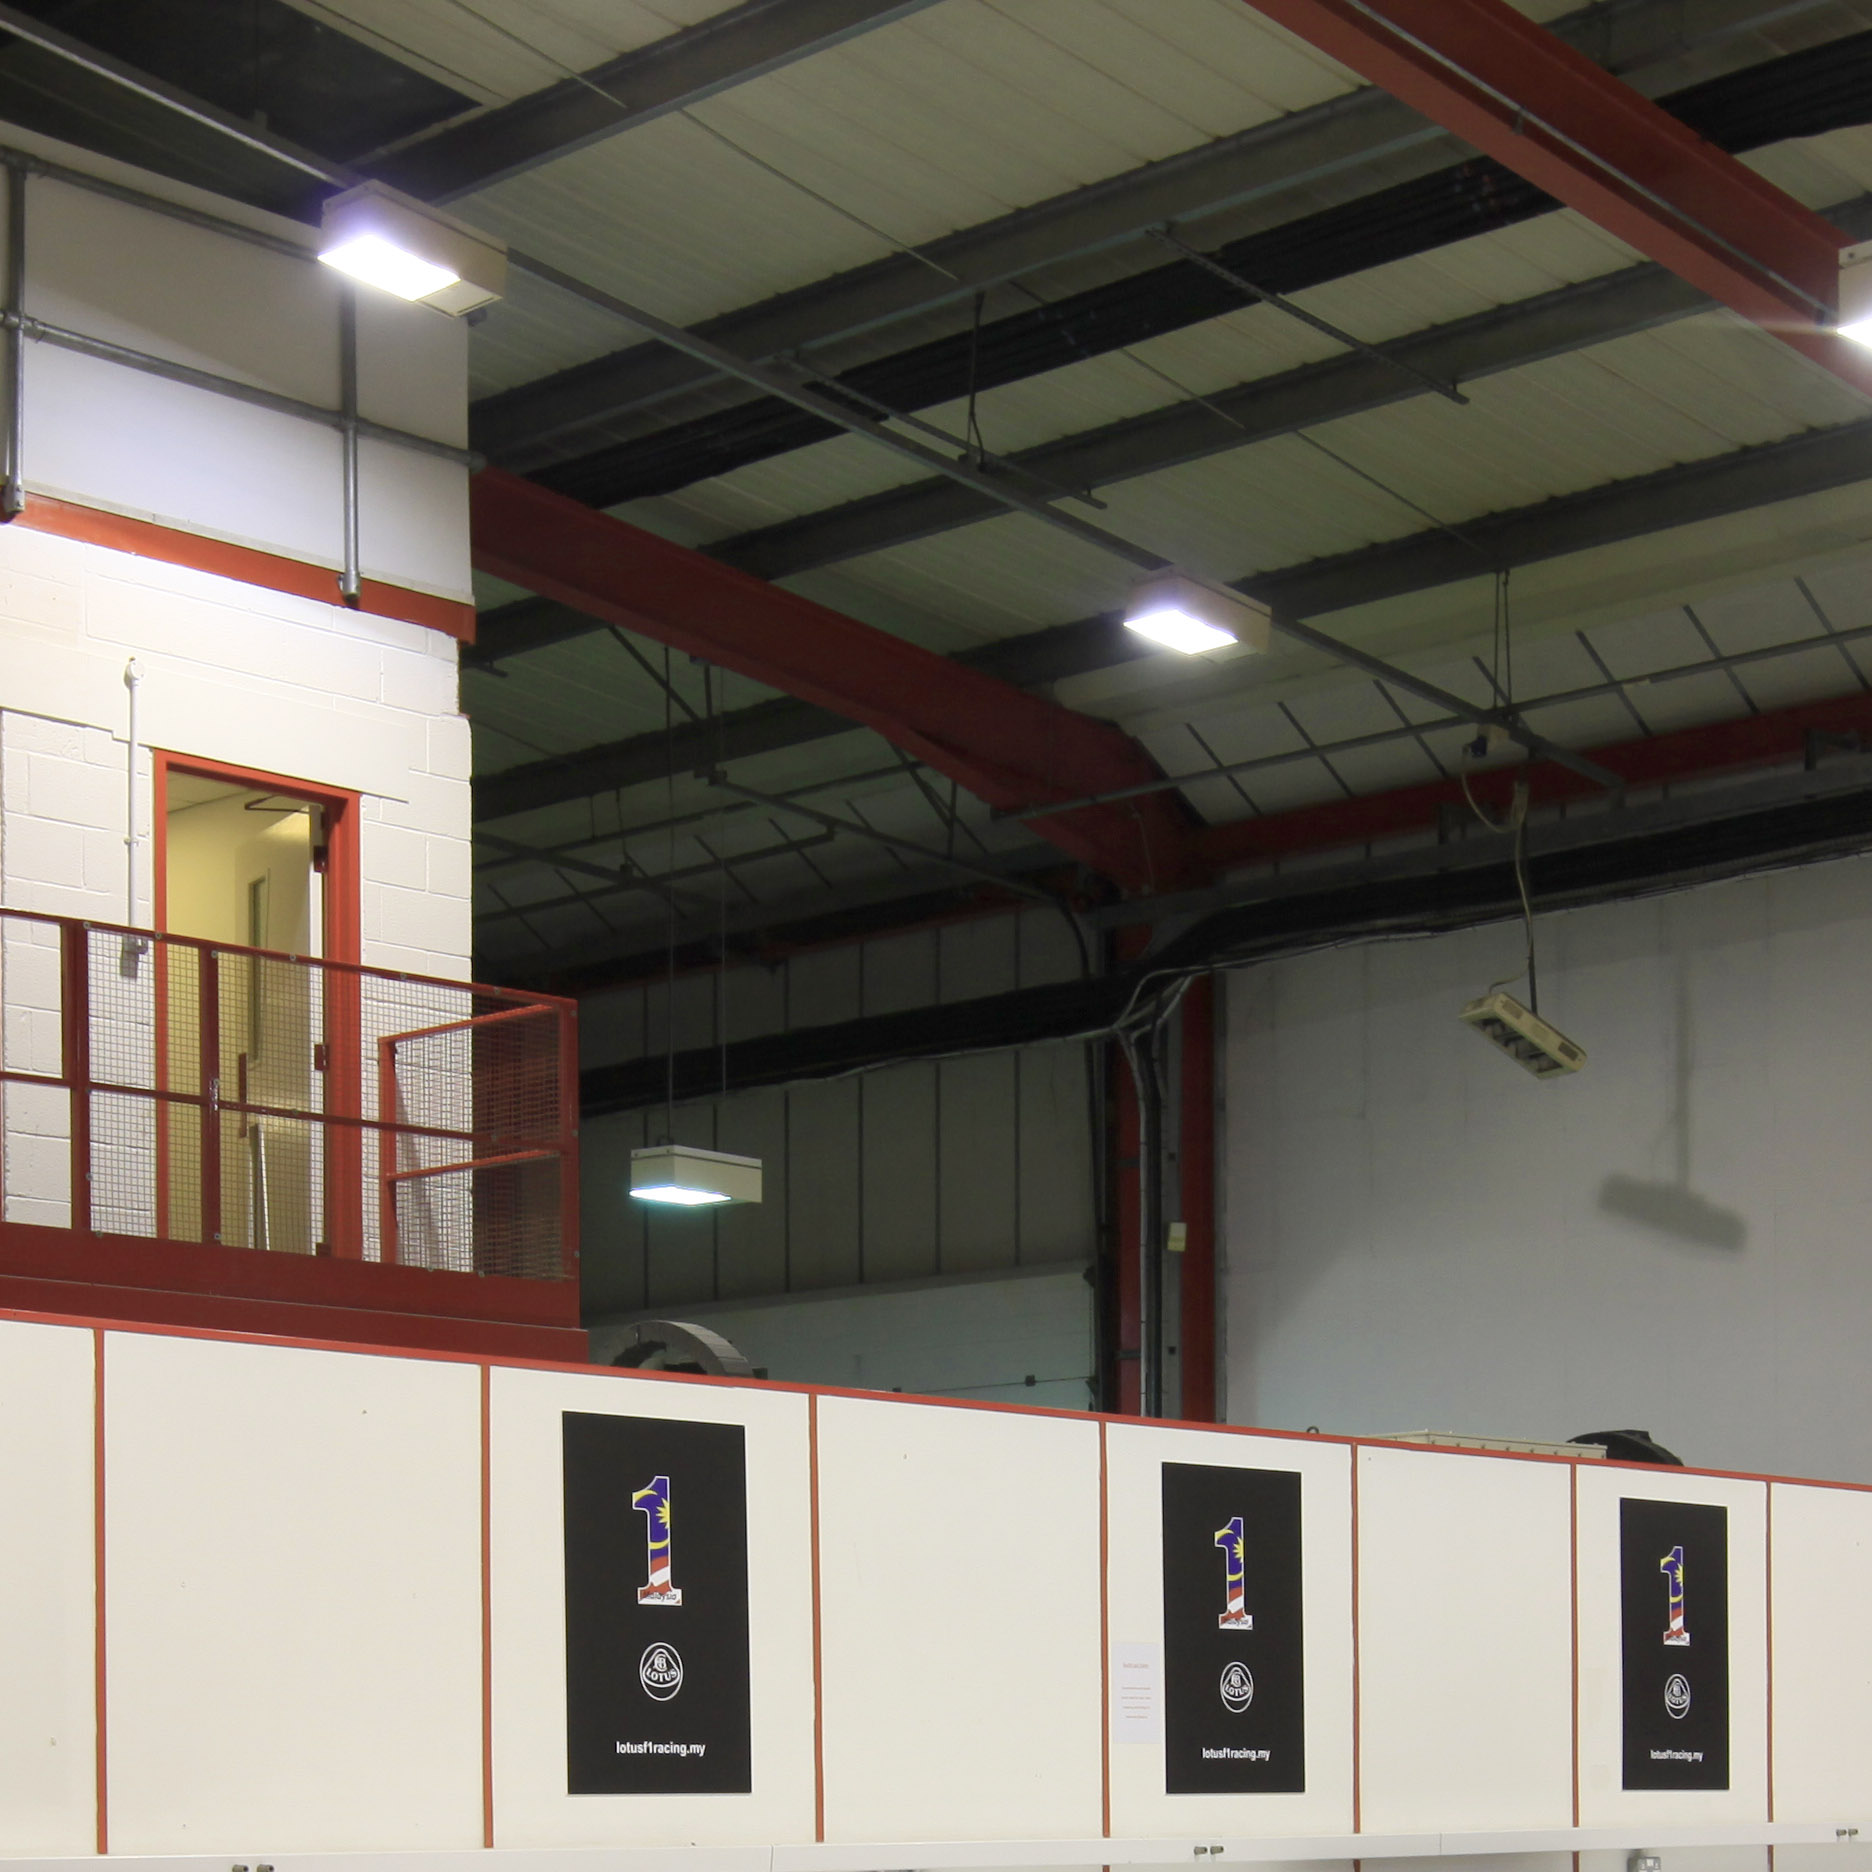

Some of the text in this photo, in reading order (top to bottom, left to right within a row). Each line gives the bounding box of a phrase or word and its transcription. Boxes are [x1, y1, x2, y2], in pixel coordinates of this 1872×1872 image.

[632, 1475, 682, 1606] 1
[1214, 1516, 1253, 1630] 1
[1660, 1546, 1690, 1646] 1
[645, 1667, 678, 1682] LOTUS
[616, 1741, 706, 1757] lotusf1racing.my
[1202, 1747, 1271, 1762] lotusf1racing.my
